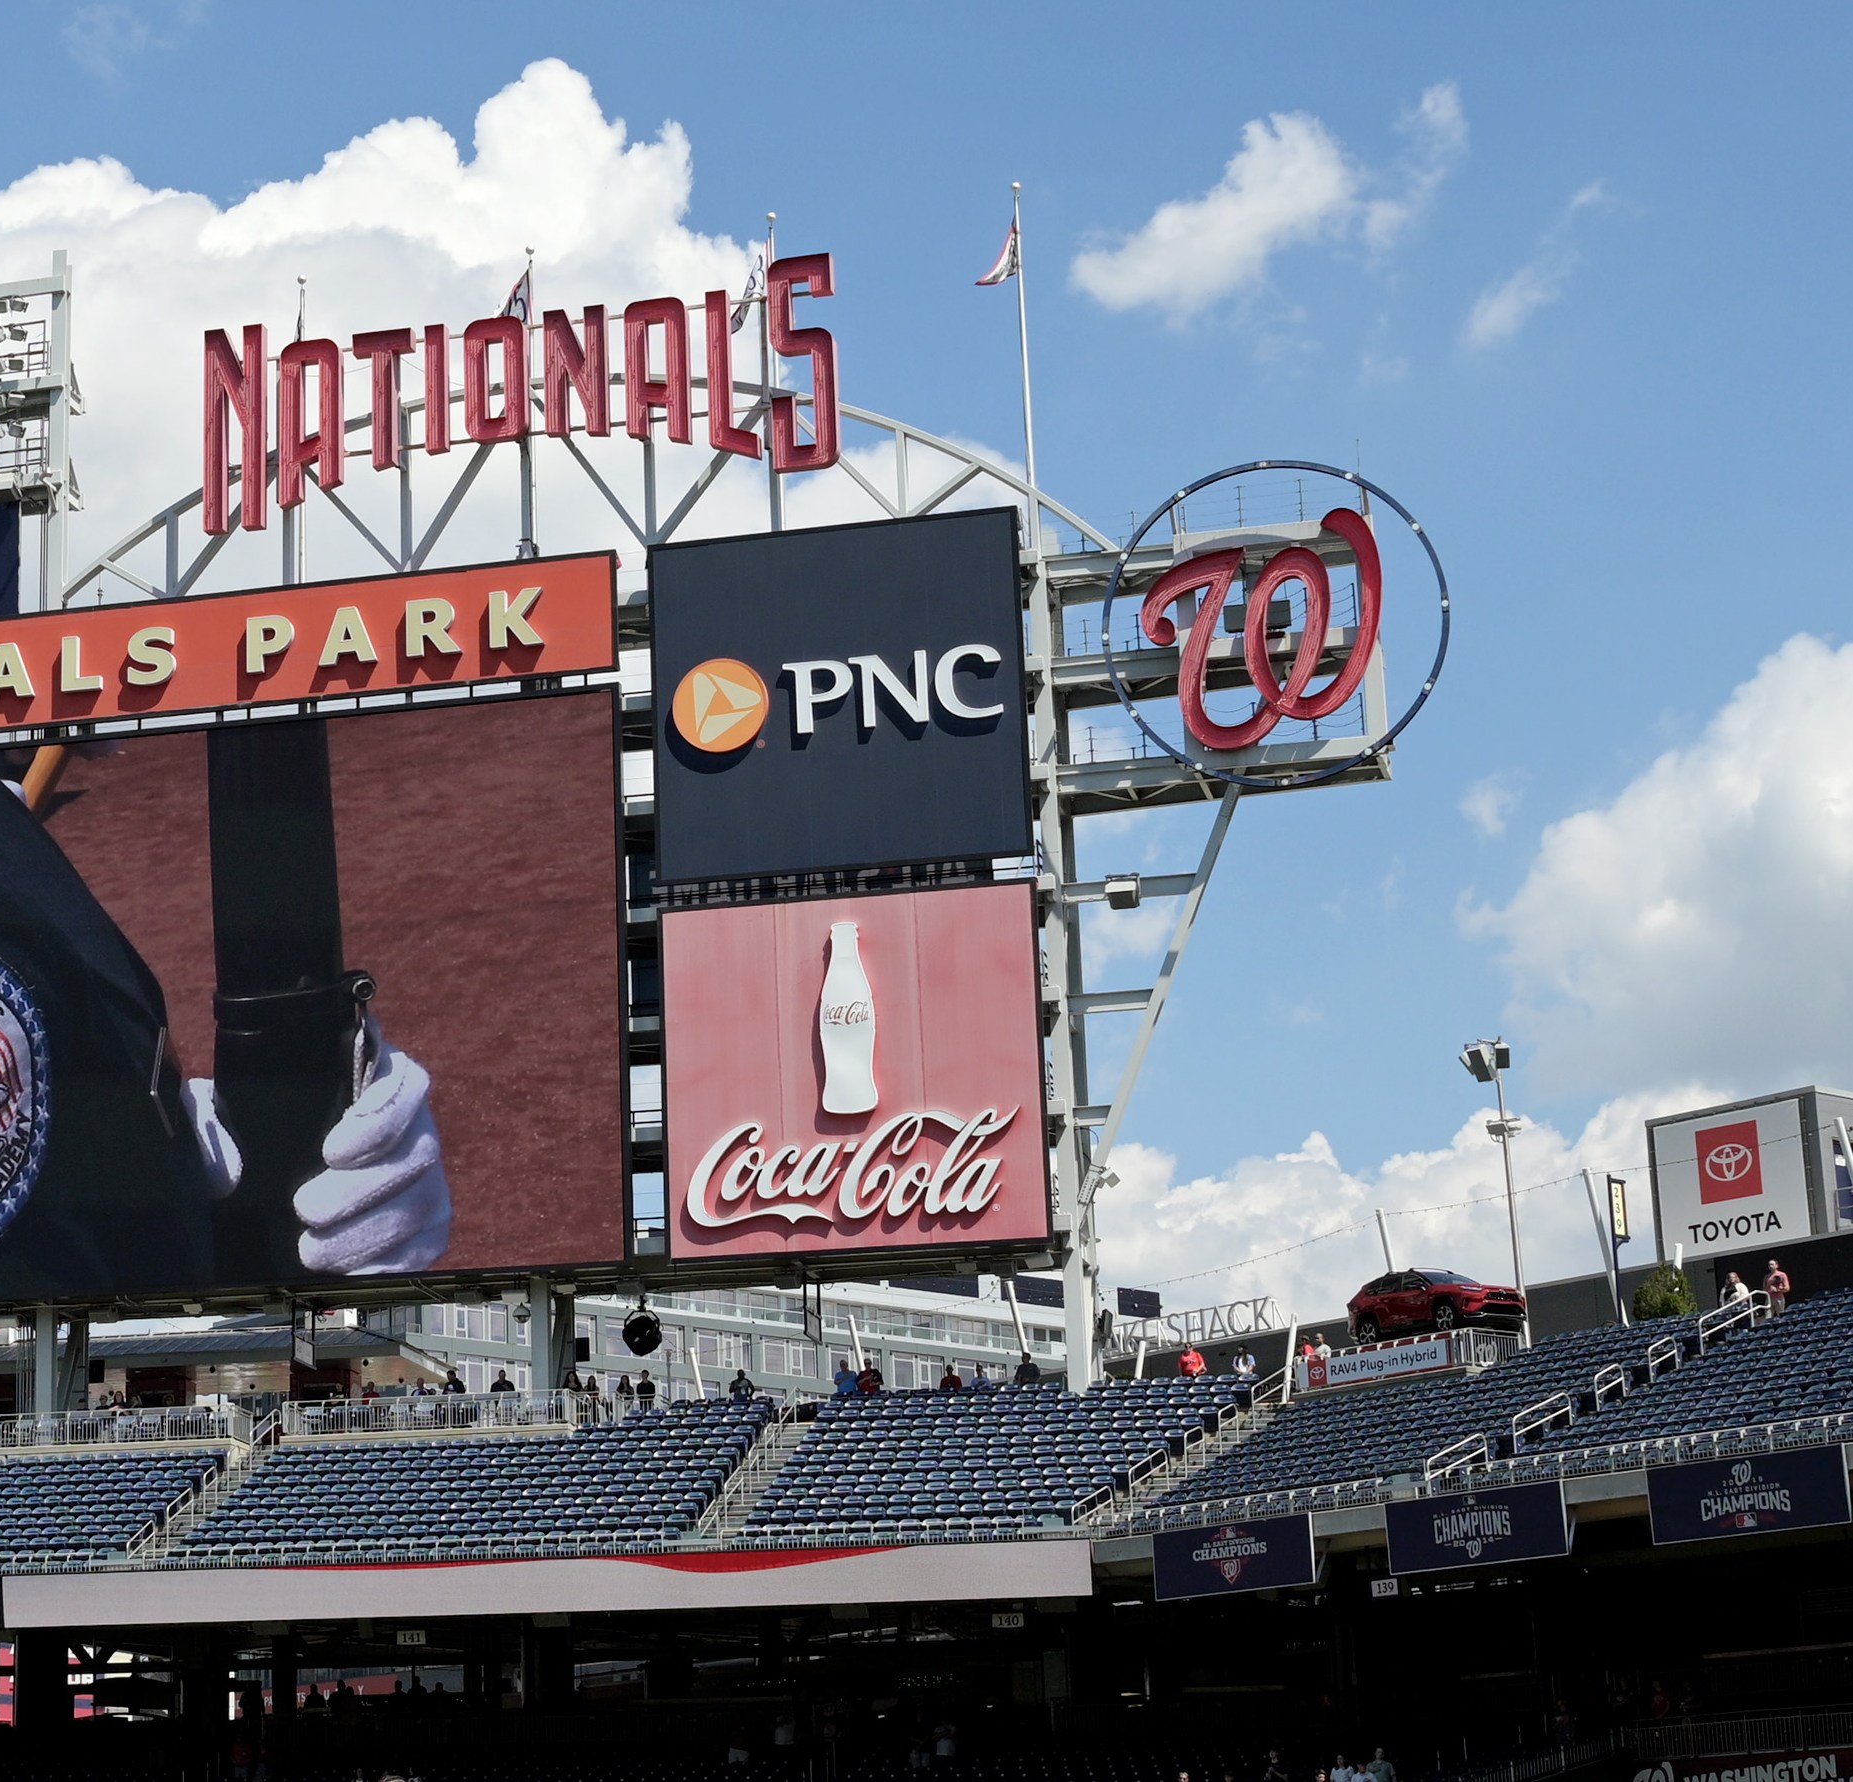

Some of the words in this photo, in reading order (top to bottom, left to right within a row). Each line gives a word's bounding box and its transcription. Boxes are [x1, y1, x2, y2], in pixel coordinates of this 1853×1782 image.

[202, 252, 840, 536] NATIONALS
[245, 586, 546, 675] PARK
[782, 644, 1004, 734] PNC
[687, 1105, 1021, 1227] Coca-Cola
[1688, 1211, 1782, 1243] TOYOTA
[1167, 1296, 1271, 1346] SHACK
[1330, 1360, 1357, 1377] RAV4
[1359, 1357, 1398, 1375] Plug-in
[1400, 1347, 1437, 1368] Hybrid
[1724, 1486, 1742, 1494] EAST
[1745, 1482, 1780, 1492] DIVISION
[1701, 1489, 1791, 1521] CHAMPIONS
[1229, 1537, 1255, 1546] DIVISION
[1433, 1511, 1511, 1544] CHAMPIONS
[1192, 1542, 1268, 1562] CHAMPIONS
[1376, 1582, 1394, 1594] 139
[997, 1615, 1020, 1627] 140
[402, 1632, 421, 1643] 141
